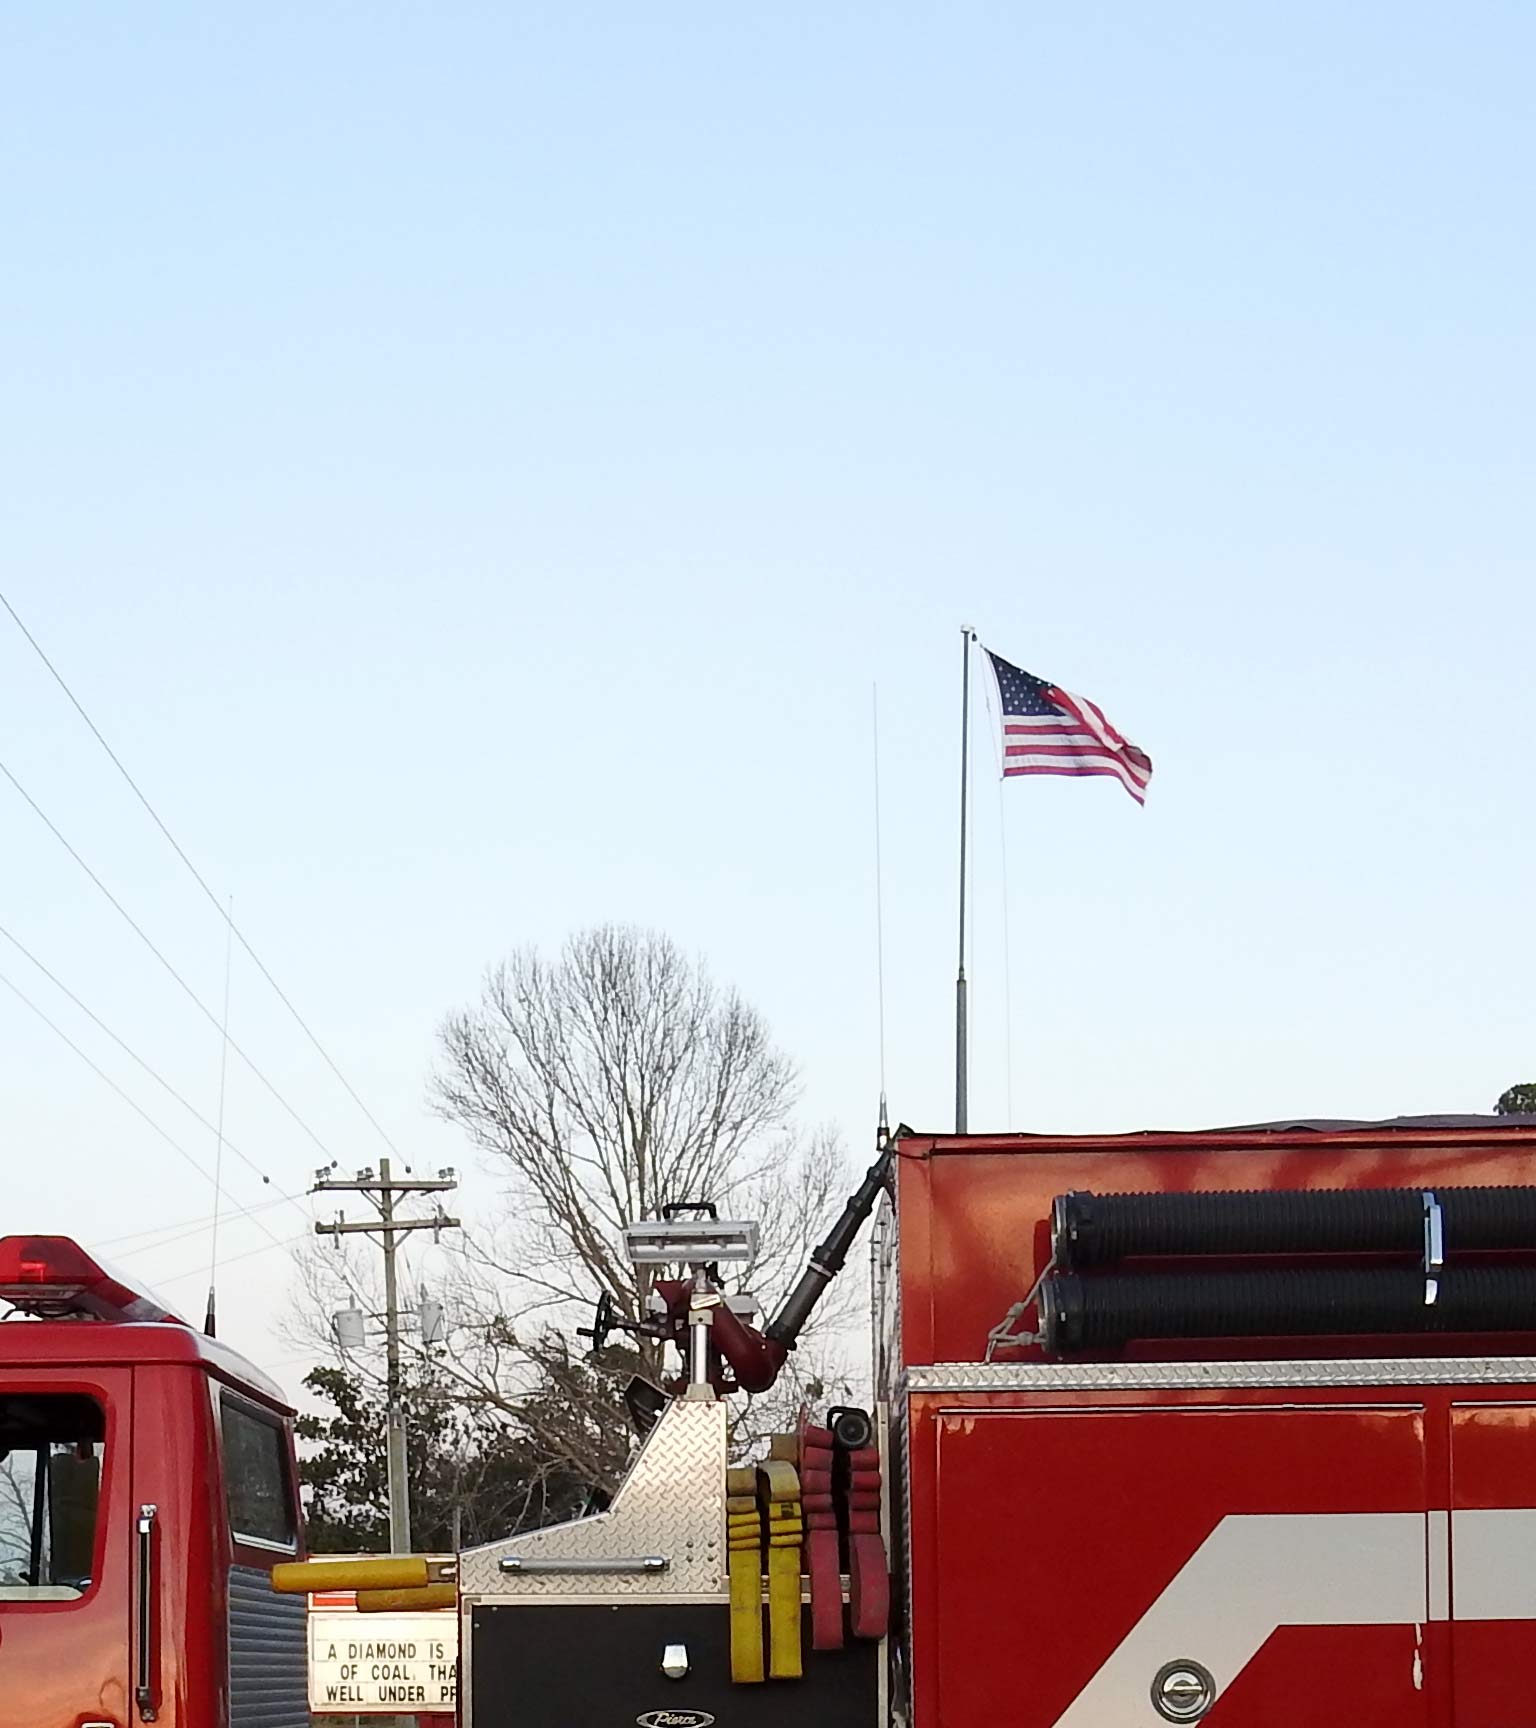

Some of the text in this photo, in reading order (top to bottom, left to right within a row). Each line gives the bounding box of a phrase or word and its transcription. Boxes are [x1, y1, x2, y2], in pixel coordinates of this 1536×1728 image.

[328, 1642, 444, 1660] A DIAMOND IS
[340, 1664, 358, 1681] OF
[429, 1664, 457, 1681] THA
[326, 1685, 364, 1702] WELL
[379, 1685, 426, 1702] UNDER
